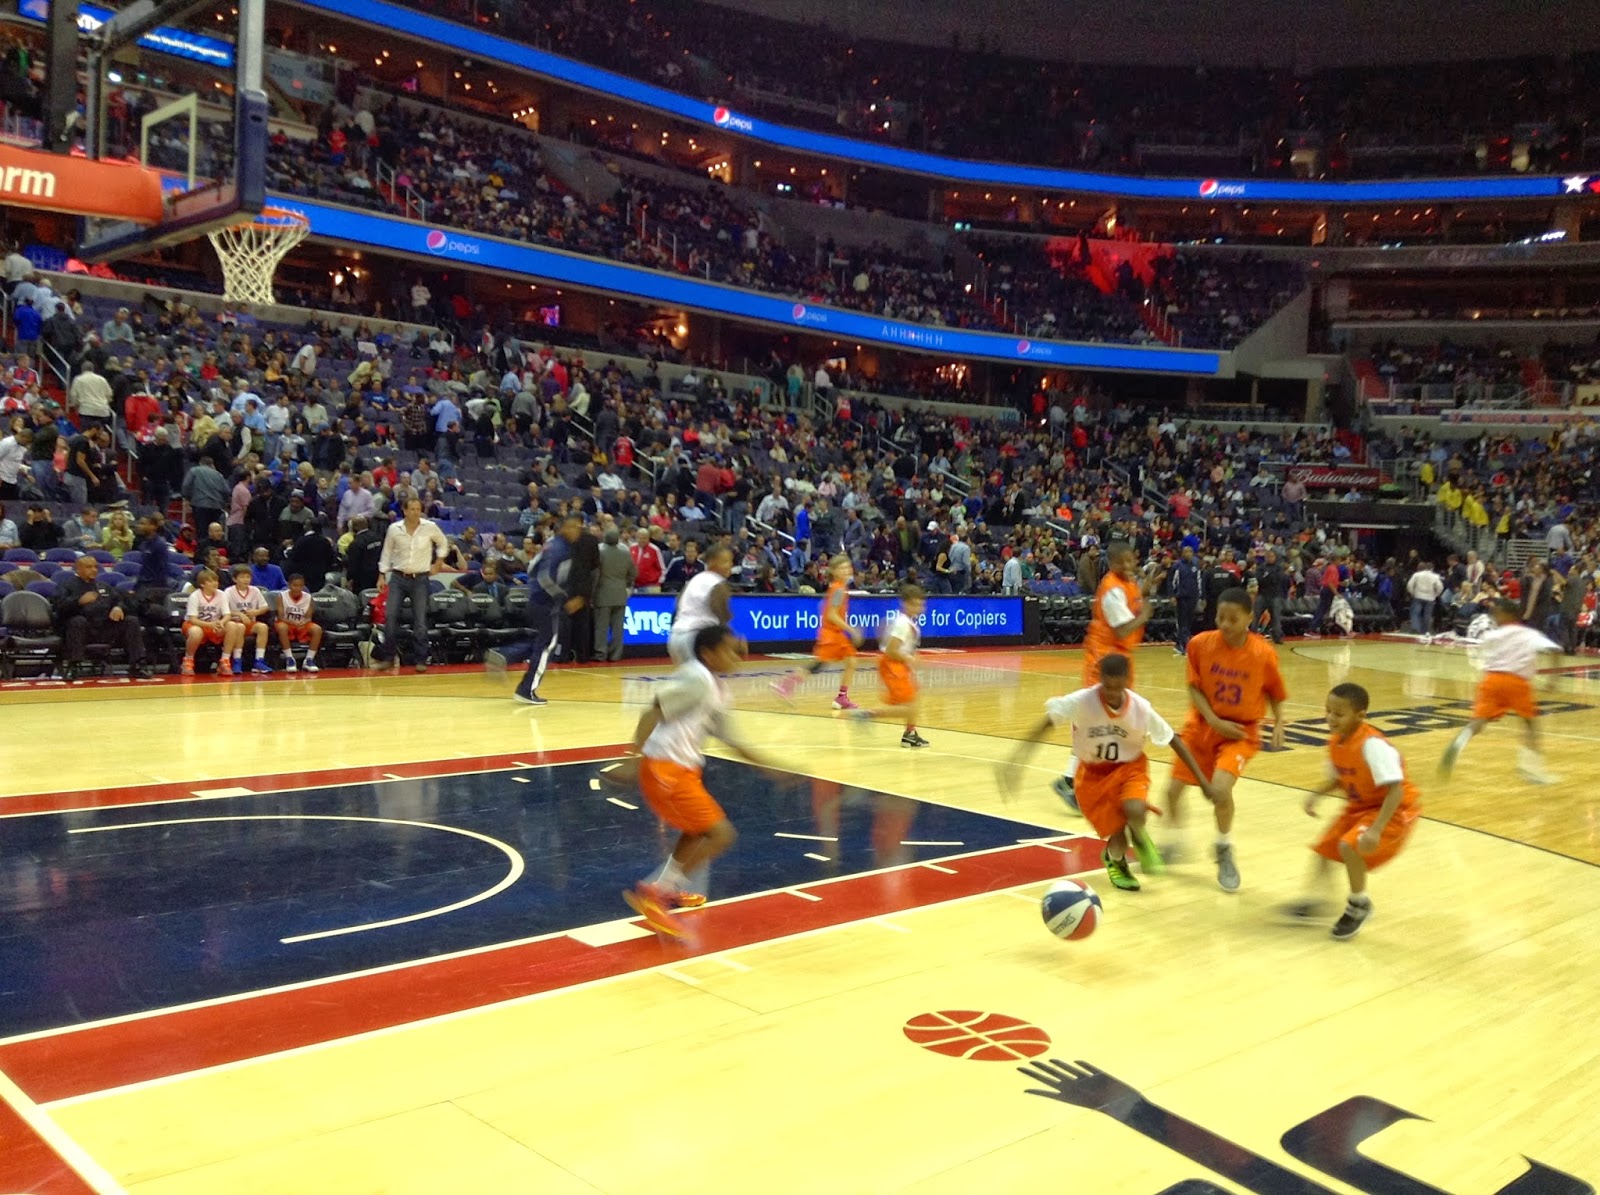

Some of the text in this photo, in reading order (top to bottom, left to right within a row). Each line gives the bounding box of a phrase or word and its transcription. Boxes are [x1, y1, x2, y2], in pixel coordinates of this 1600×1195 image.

[729, 117, 752, 130] pepsi
[1217, 184, 1245, 196] pepsi
[448, 241, 480, 255] pepsi
[1289, 468, 1378, 485] Budweiser
[623, 605, 673, 636] Ame
[749, 610, 789, 630] Your
[931, 609, 950, 626] for
[955, 608, 1007, 629] Copiers
[1214, 682, 1242, 706] 23
[1096, 742, 1119, 761] 10
